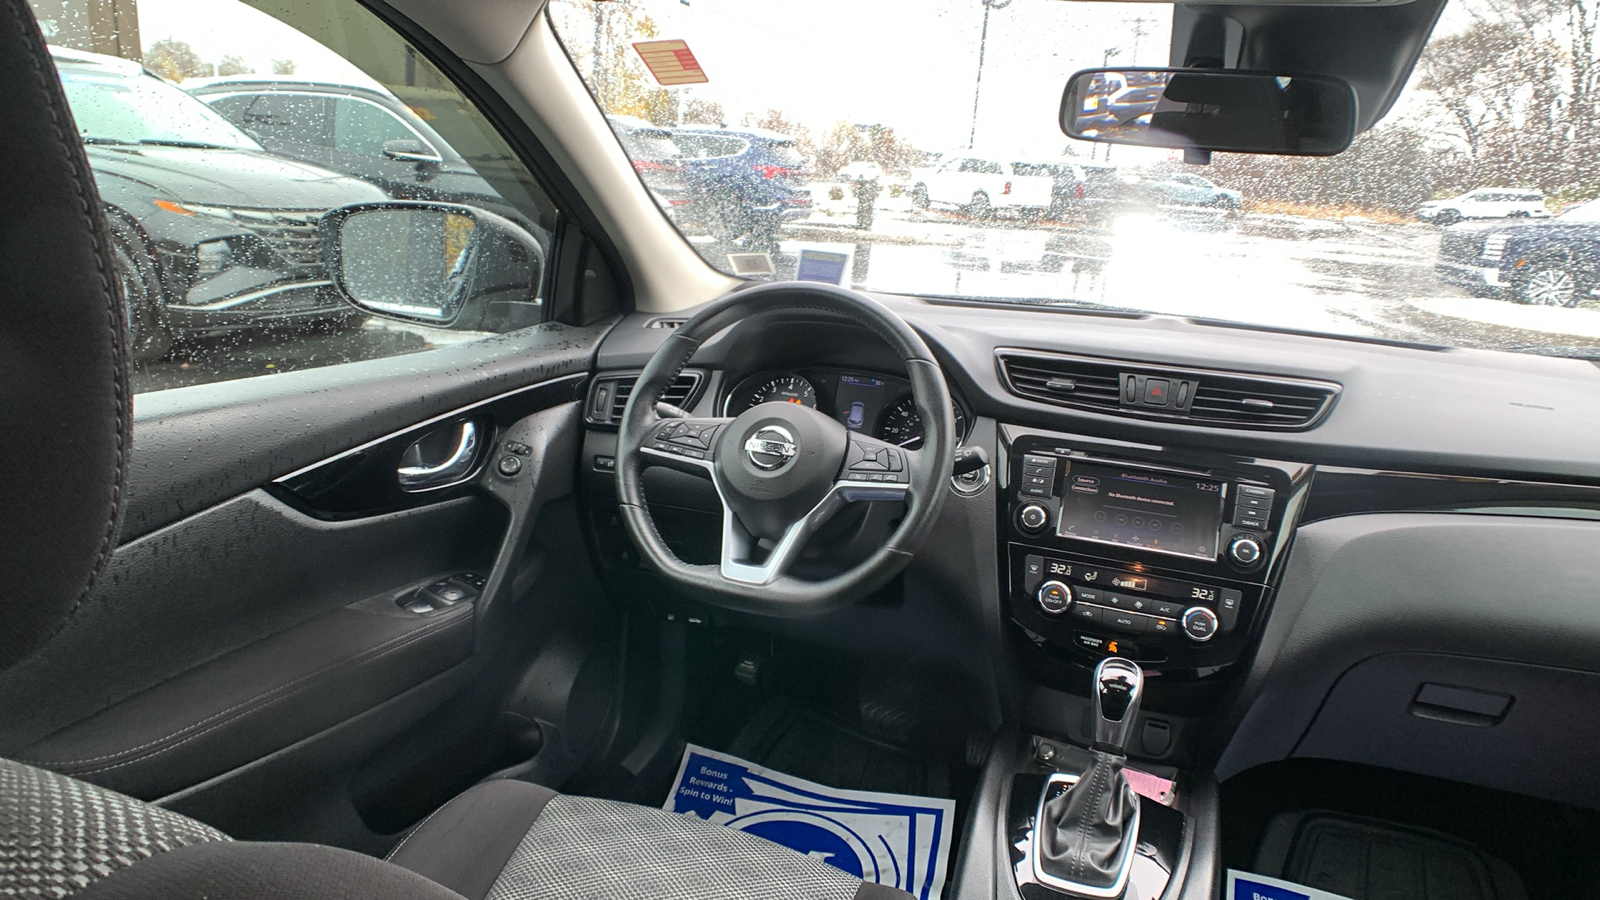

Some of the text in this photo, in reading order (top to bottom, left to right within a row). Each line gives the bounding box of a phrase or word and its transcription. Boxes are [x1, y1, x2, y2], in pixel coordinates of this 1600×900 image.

[748, 441, 790, 453] NISSAN
[1077, 476, 1095, 484] Source
[1121, 473, 1149, 482] Bluetooth
[1196, 482, 1220, 492] 12:25
[1080, 635, 1103, 644] PASSENGER
[700, 766, 729, 780] Bonus
[689, 776, 728, 792] Rewards
[679, 786, 734, 806] Spin to Win!
